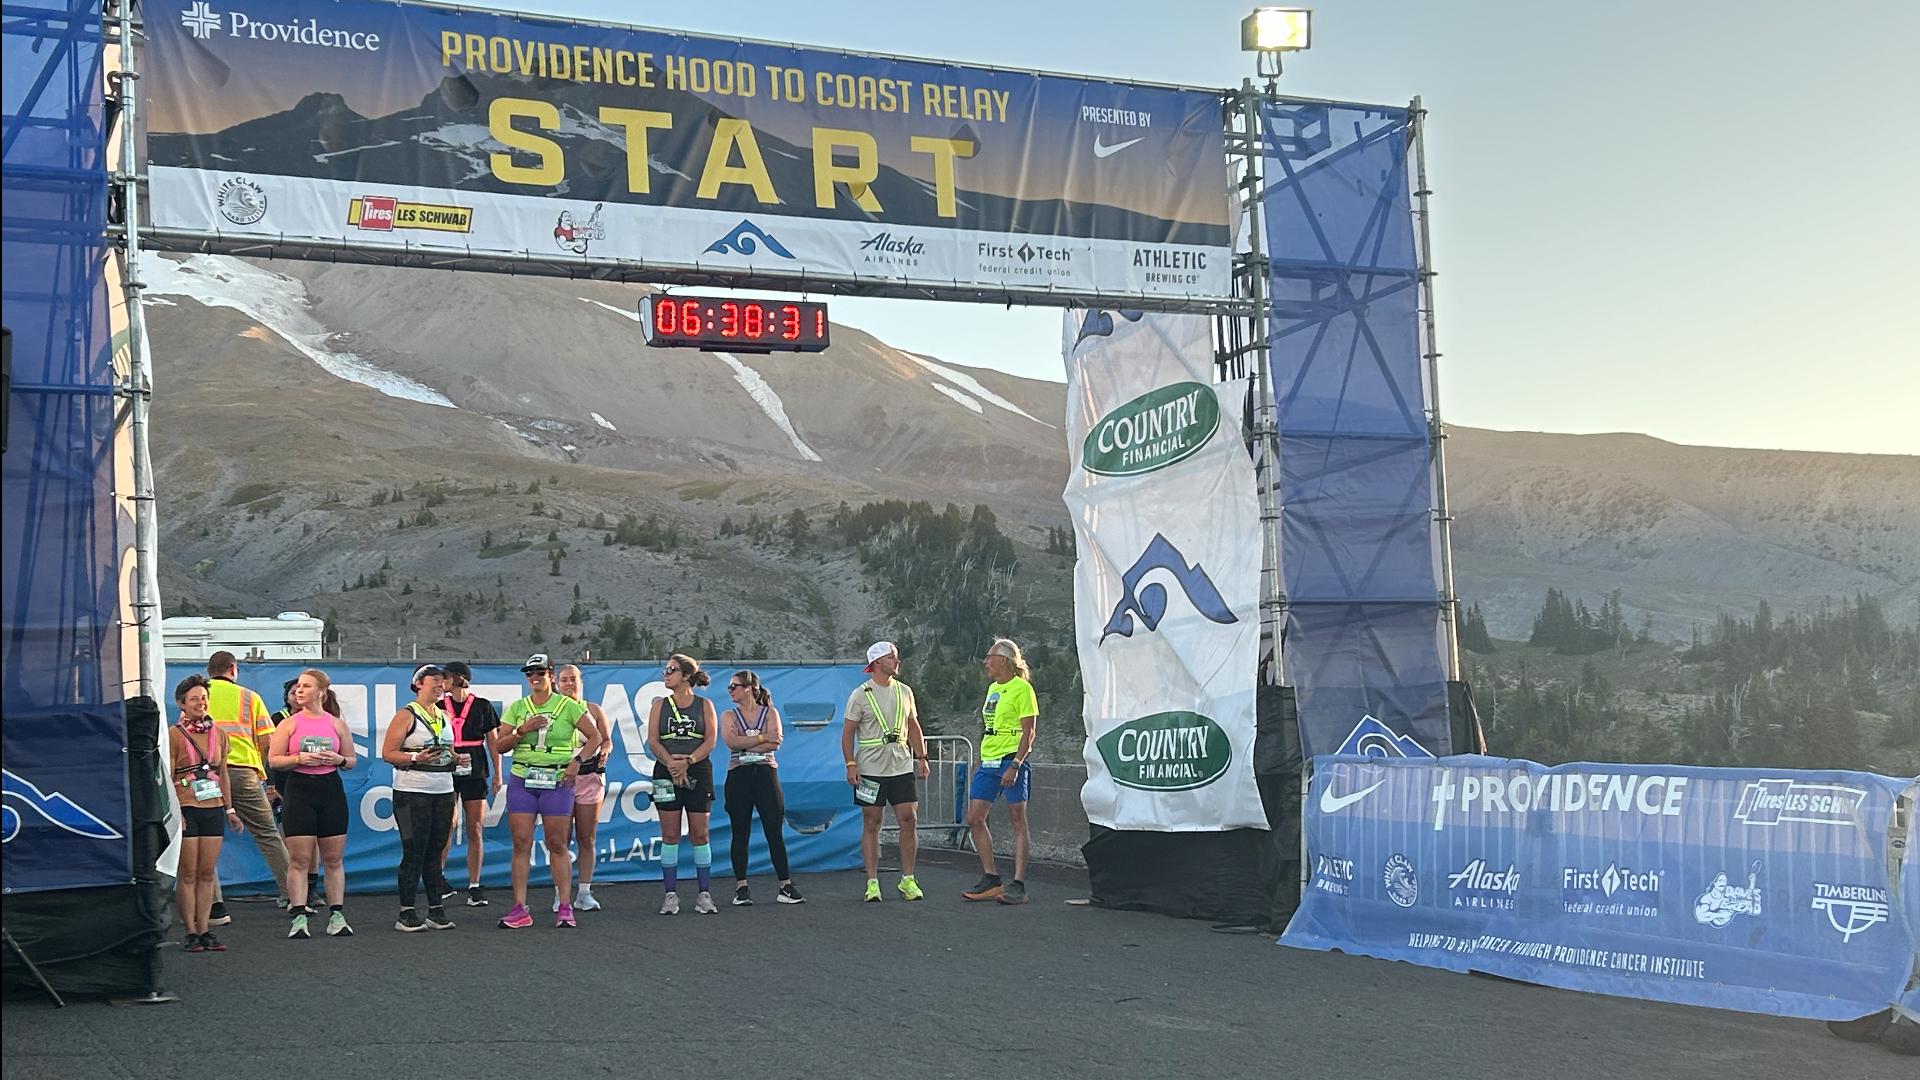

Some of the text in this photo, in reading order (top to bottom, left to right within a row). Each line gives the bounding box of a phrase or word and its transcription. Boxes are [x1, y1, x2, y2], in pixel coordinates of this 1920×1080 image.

[229, 12, 380, 51] Providence
[441, 31, 1010, 123] PROVIDENCE HOOD TO COAST RELAY
[1082, 106, 1151, 128] PRESENTED BY
[489, 97, 974, 219] START
[217, 176, 264, 208] WHITE CLAW
[364, 201, 467, 226] Tires LES SCHWAB
[860, 232, 924, 256] Alaska
[978, 242, 1070, 262] First Tech
[864, 255, 918, 266] AIRLINES
[979, 263, 1071, 277] federal credit union
[1133, 249, 1207, 270] ATHLETIC
[1145, 272, 1183, 284] BREWING
[1097, 389, 1199, 454] COUNTRY
[1122, 434, 1185, 467] FINANCIAL
[281, 645, 317, 655] ITASCA
[1117, 725, 1208, 762] COUNTRY
[1139, 762, 1197, 779] FINANCIAL
[1461, 774, 1688, 816] PROVIDENCE
[1753, 787, 1785, 811] Tires
[1784, 794, 1808, 811] LES
[1383, 857, 1398, 889] WHITE
[1448, 859, 1520, 896] Alaska
[1563, 868, 1659, 892] First Tech
[1454, 897, 1514, 910] AIRLINES
[1564, 901, 1658, 918] federal credit union
[1442, 936, 1457, 951] TO
[1478, 935, 1512, 952] CANCER
[1508, 941, 1552, 960] THROUGH
[1610, 951, 1648, 973] CANCER
[1650, 956, 1705, 979] INSTITUTE
